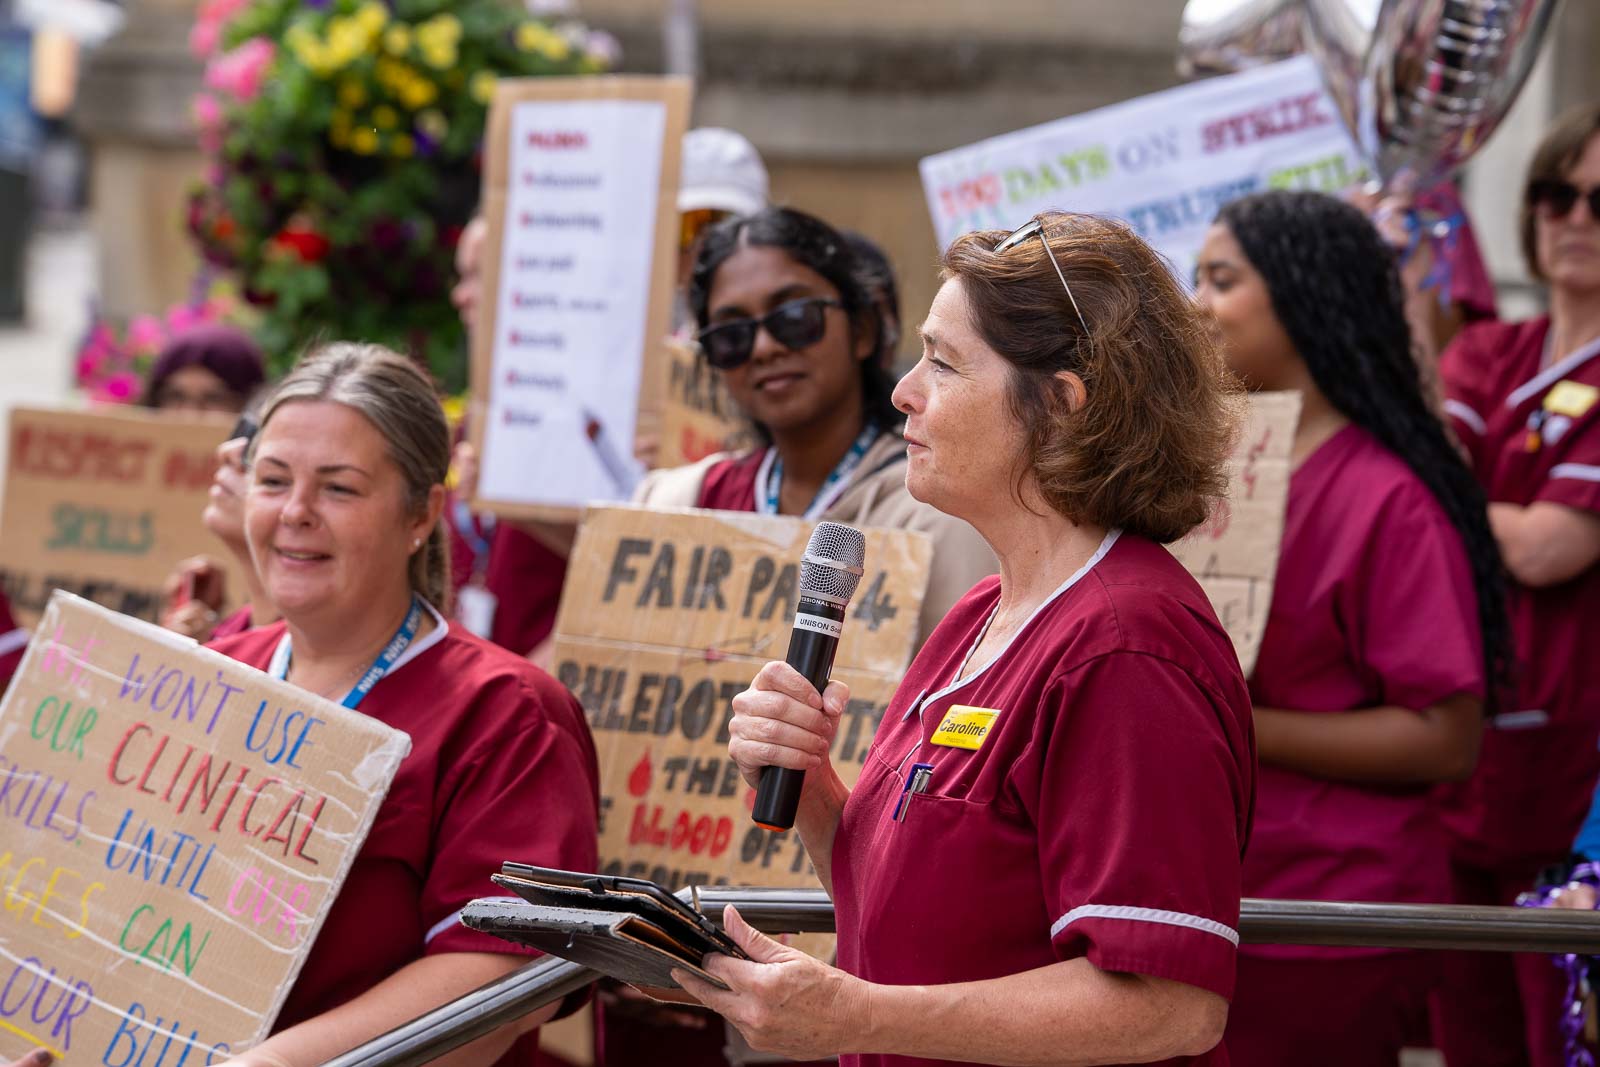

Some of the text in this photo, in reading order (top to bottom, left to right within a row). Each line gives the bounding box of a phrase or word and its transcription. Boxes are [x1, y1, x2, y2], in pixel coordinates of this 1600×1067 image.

[1004, 144, 1111, 204] DAYS
[1116, 125, 1180, 174] ON
[1200, 91, 1334, 154] STRIK
[602, 538, 899, 631] FAIR PA 4
[383, 635, 409, 662] NHS
[800, 618, 829, 630] UNISON
[118, 653, 245, 735] WON'T
[245, 700, 326, 770] USE
[357, 667, 384, 693] NHS
[940, 718, 987, 737] Caroline
[30, 695, 327, 865] OUR CLINICAL
[663, 756, 740, 799] THE
[105, 808, 217, 901] UNTIL
[226, 867, 313, 943] OUR
[741, 823, 788, 869] OF
[118, 904, 212, 977] CAN
[0, 956, 95, 1052] OUR
